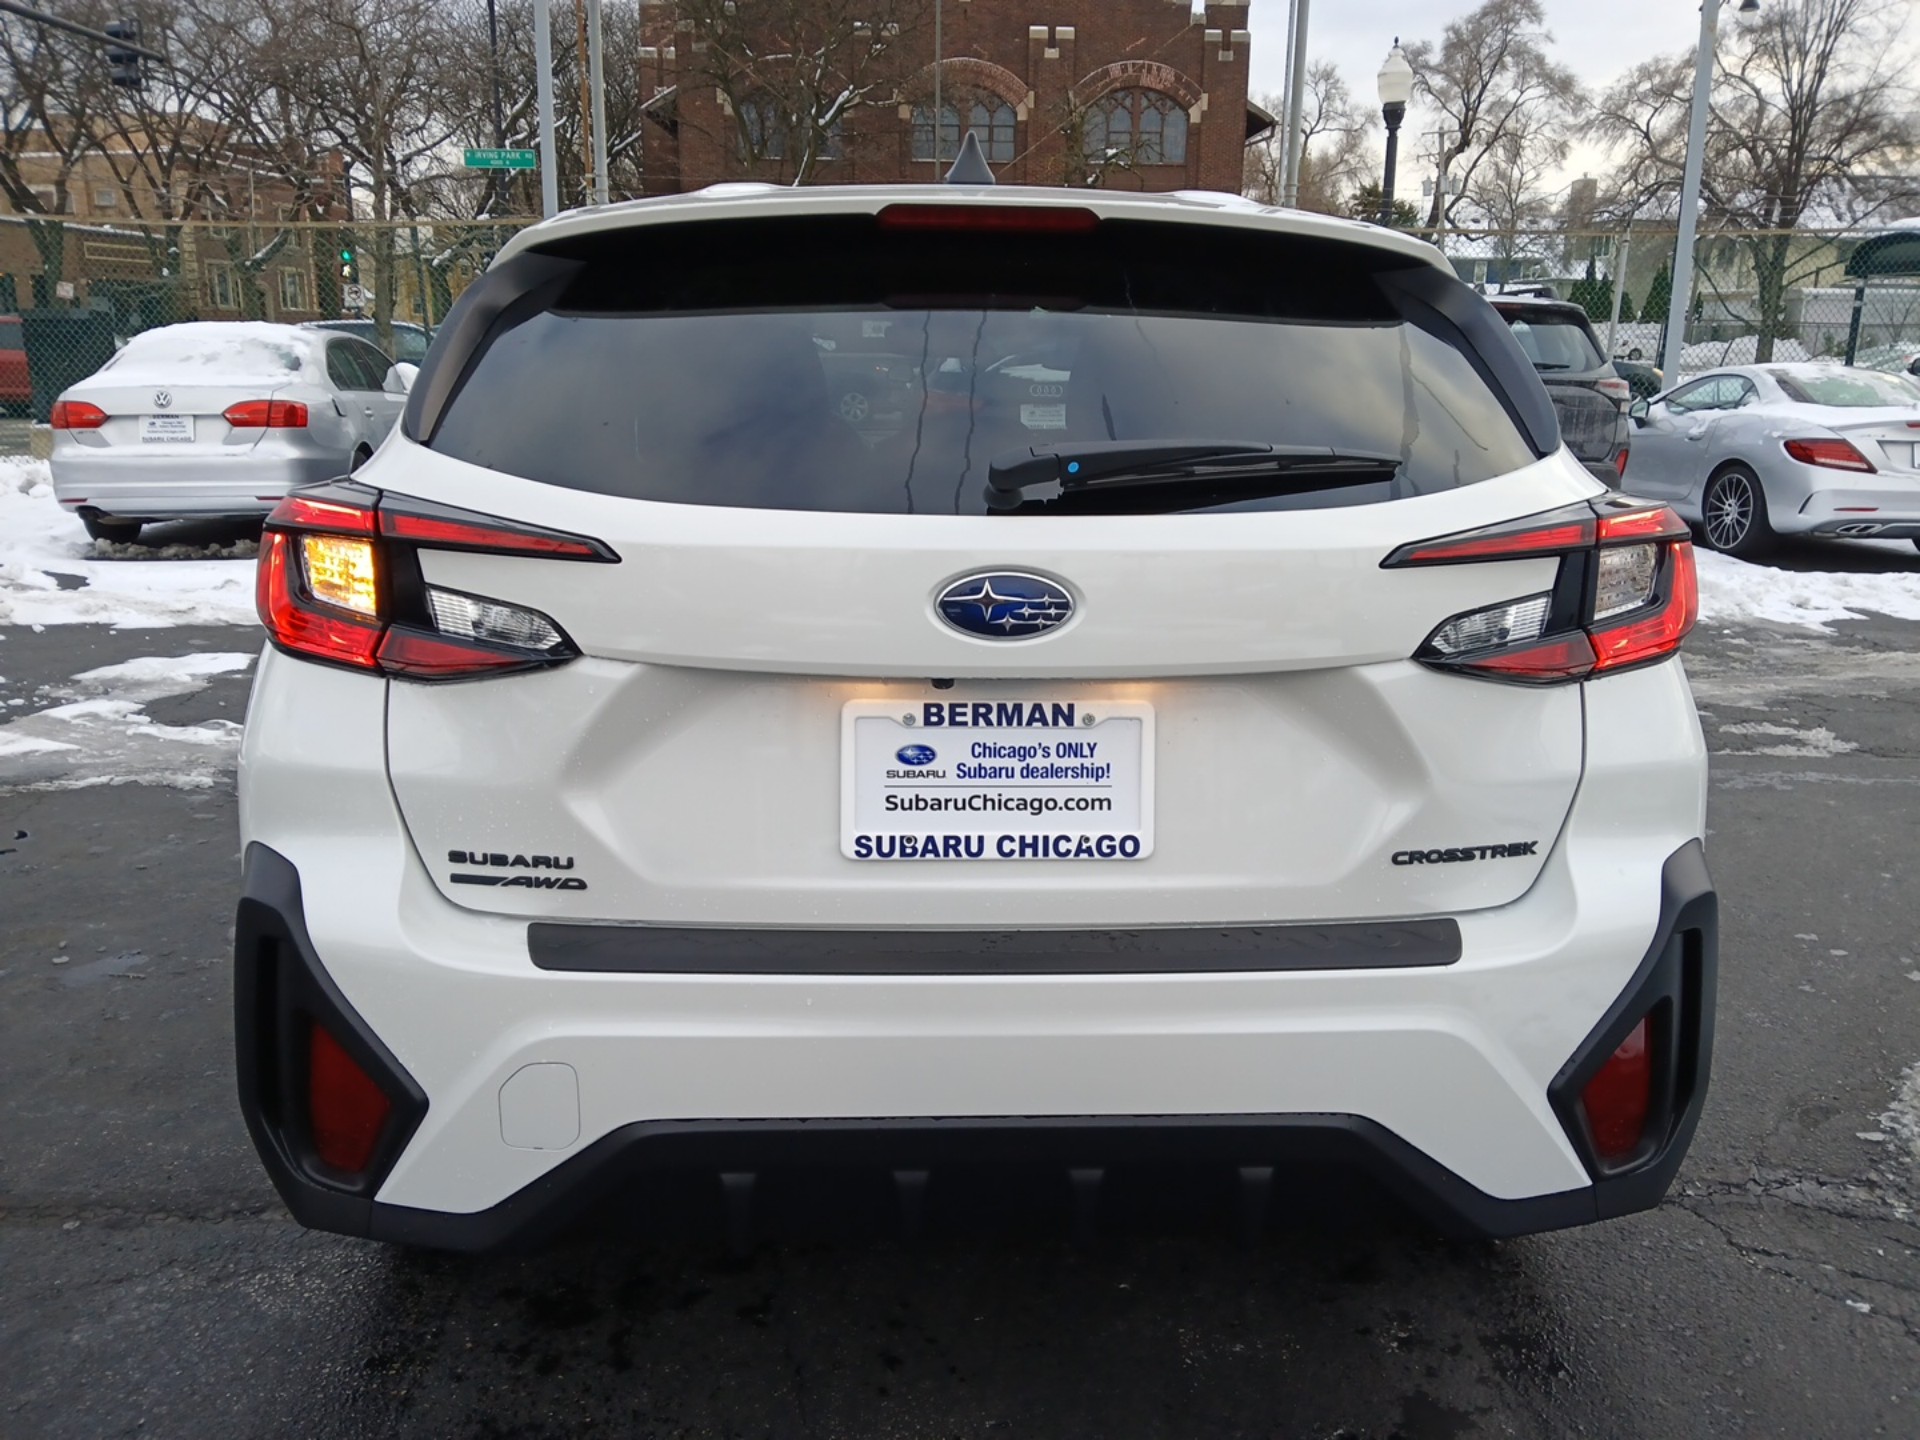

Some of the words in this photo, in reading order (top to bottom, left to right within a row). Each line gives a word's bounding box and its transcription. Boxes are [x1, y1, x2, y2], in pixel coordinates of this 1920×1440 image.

[475, 151, 498, 159] IRVING
[501, 151, 521, 159] PARK
[923, 702, 1075, 727] BERMAN
[971, 742, 1051, 761] Chicago's
[1055, 742, 1098, 759] ONLY
[886, 769, 946, 779] SUBARU
[956, 763, 1015, 779] Subaru
[1020, 763, 1111, 782] dealership!
[885, 793, 1112, 815] SubaruChicago.com
[854, 835, 985, 858] SUBARU
[996, 835, 1141, 858] CHICAGO
[1391, 840, 1539, 866] CROSSTREK
[448, 850, 574, 870] SUBARU
[501, 875, 588, 890] AWD
